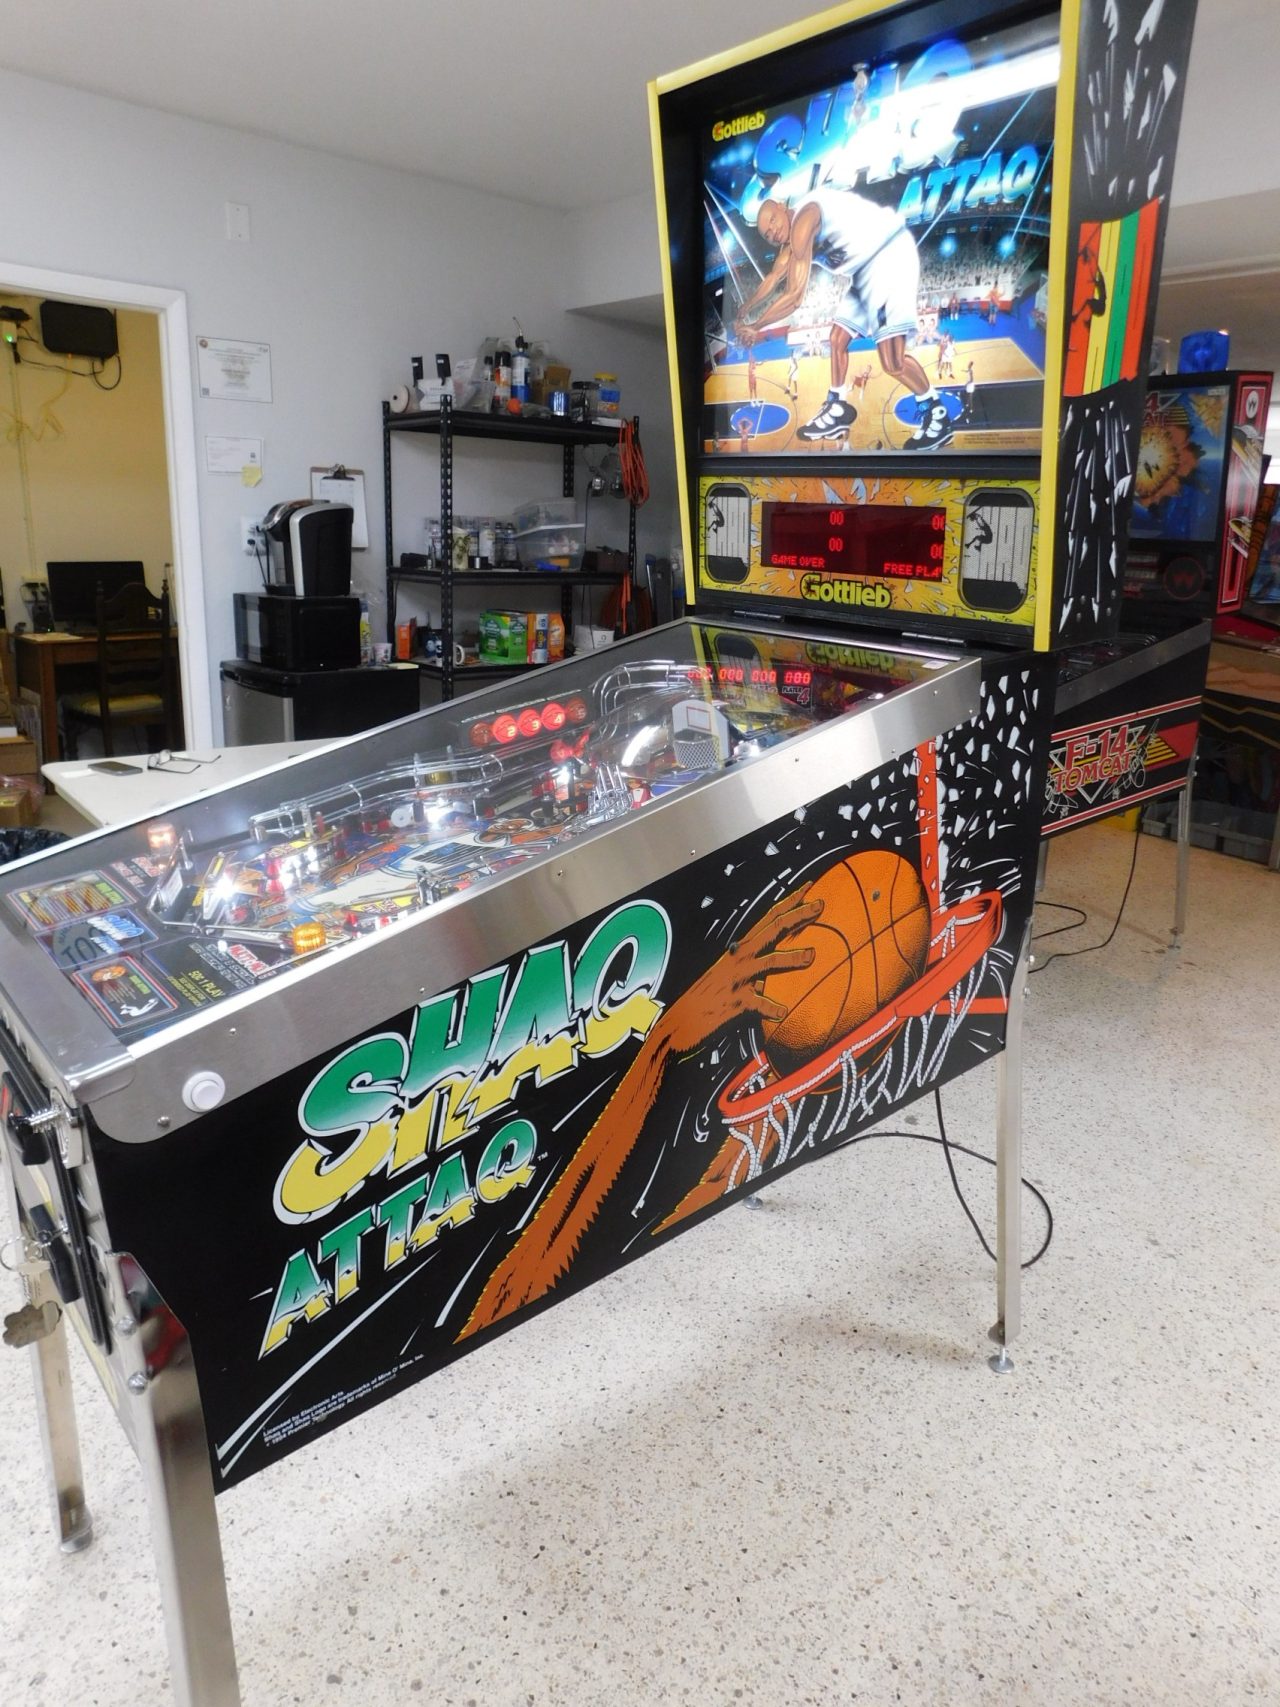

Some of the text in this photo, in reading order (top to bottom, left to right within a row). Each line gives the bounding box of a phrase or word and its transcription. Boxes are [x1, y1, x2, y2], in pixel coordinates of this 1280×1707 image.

[712, 110, 766, 142] Gottlieb
[896, 145, 1040, 226] ATTAQ
[829, 511, 844, 525] 00
[771, 554, 825, 569] GAME OVER
[828, 538, 843, 552] 00
[883, 562, 942, 578] FREE PLA
[801, 573, 892, 609] Gottlieb
[1063, 725, 1129, 770] F-14
[1052, 751, 1133, 795] TOMCAT
[272, 898, 674, 1226] SHAQ
[256, 1118, 538, 1362] ATTAQ
